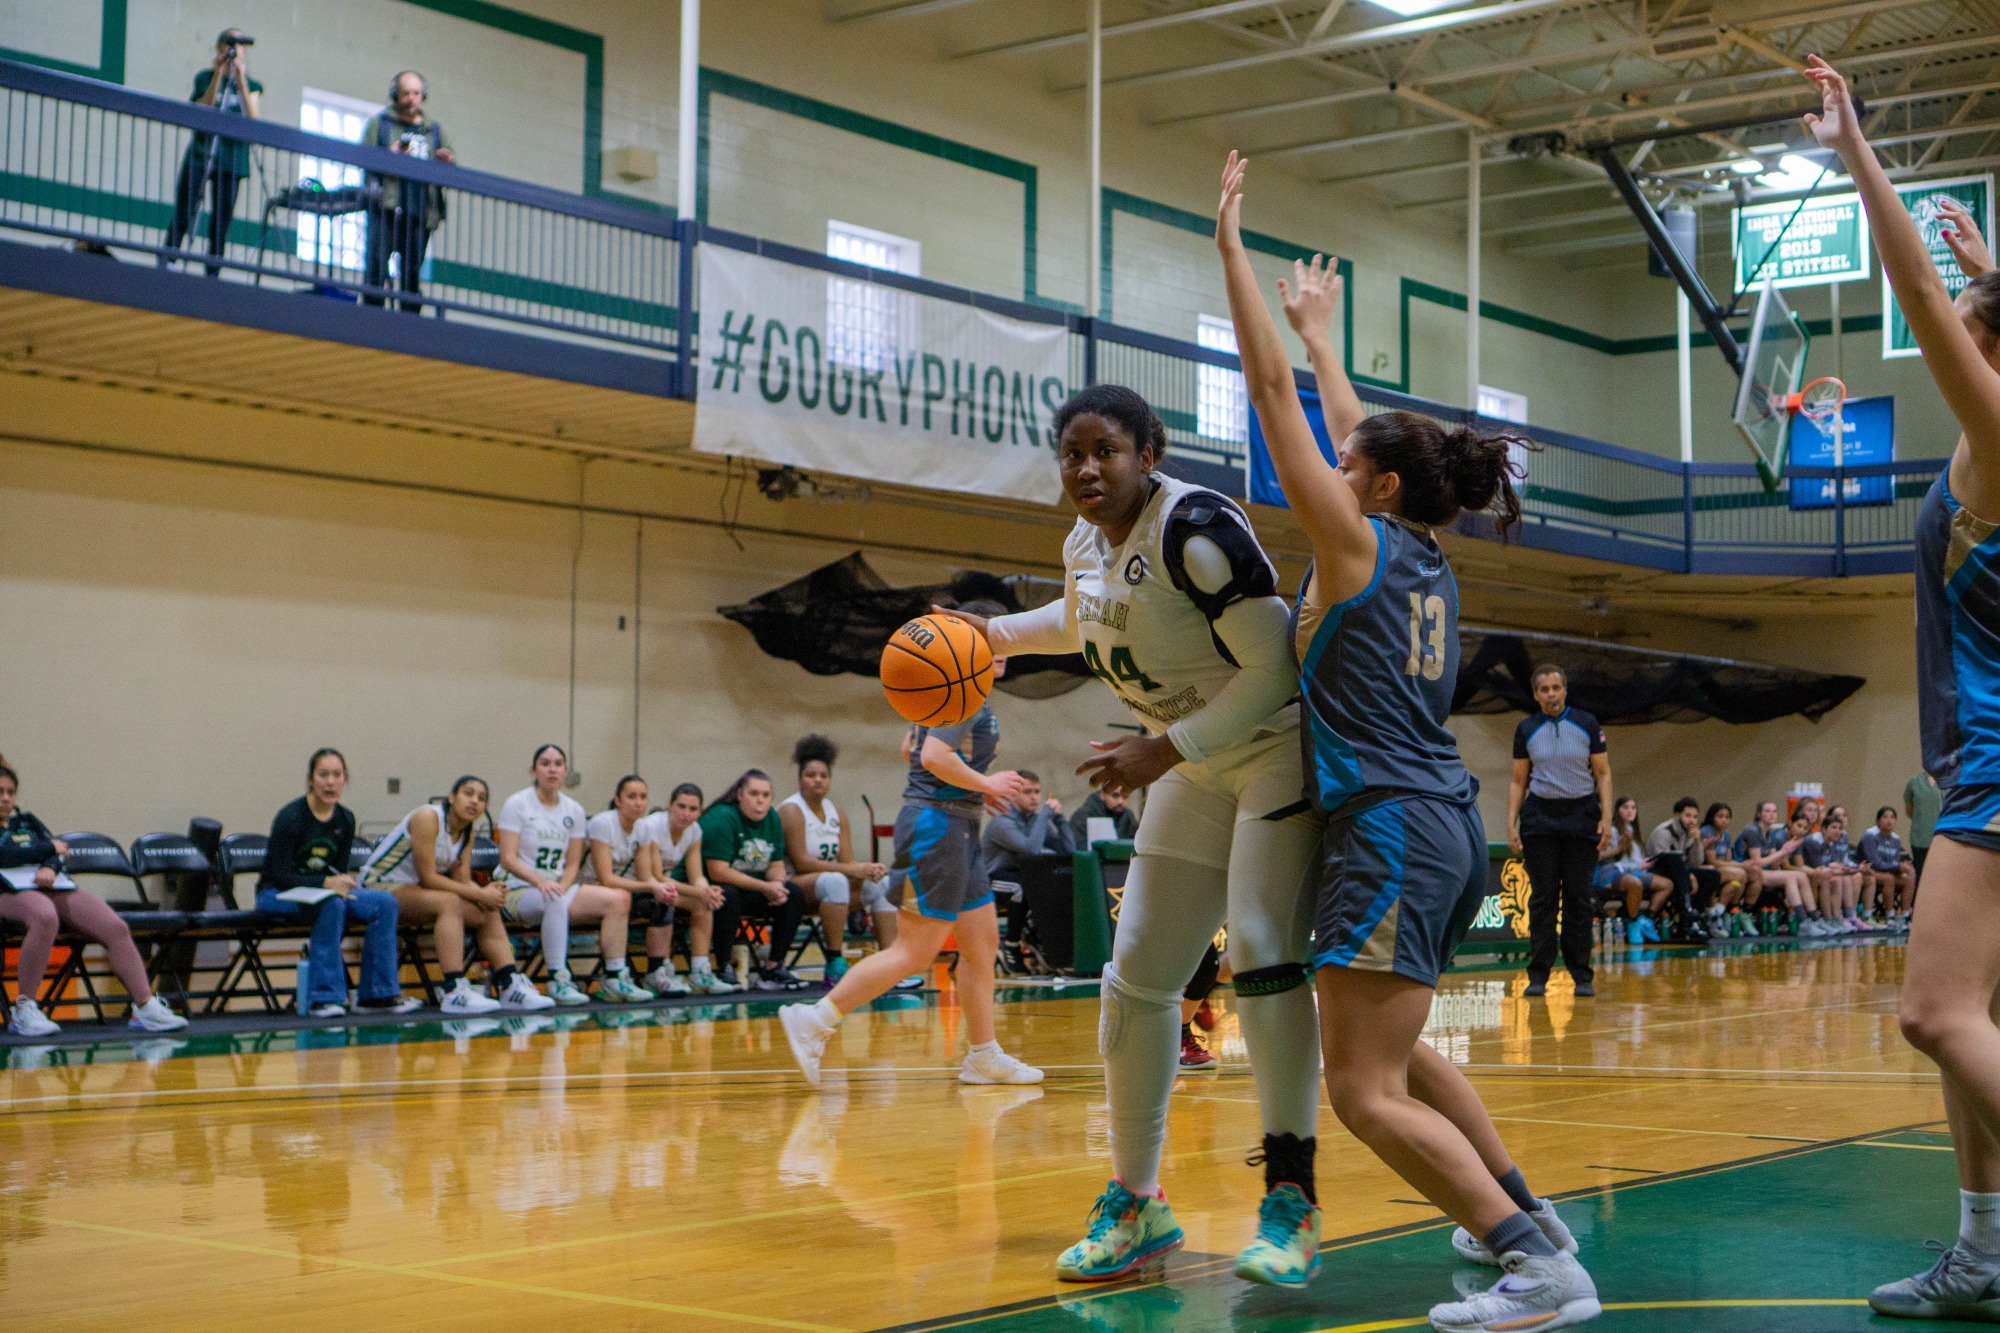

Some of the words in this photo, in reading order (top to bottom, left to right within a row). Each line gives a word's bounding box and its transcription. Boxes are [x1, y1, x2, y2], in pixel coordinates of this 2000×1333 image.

[1783, 206, 1854, 226] NATIONAL
[1763, 221, 1838, 243] CHAMPION
[1782, 254, 1851, 277] STITZEL
[712, 310, 1064, 451] #GOGRYPHONS
[1404, 592, 1446, 681] 13
[1085, 640, 1163, 692] 44
[68, 847, 118, 856] RYPHONS
[535, 847, 563, 870] 22
